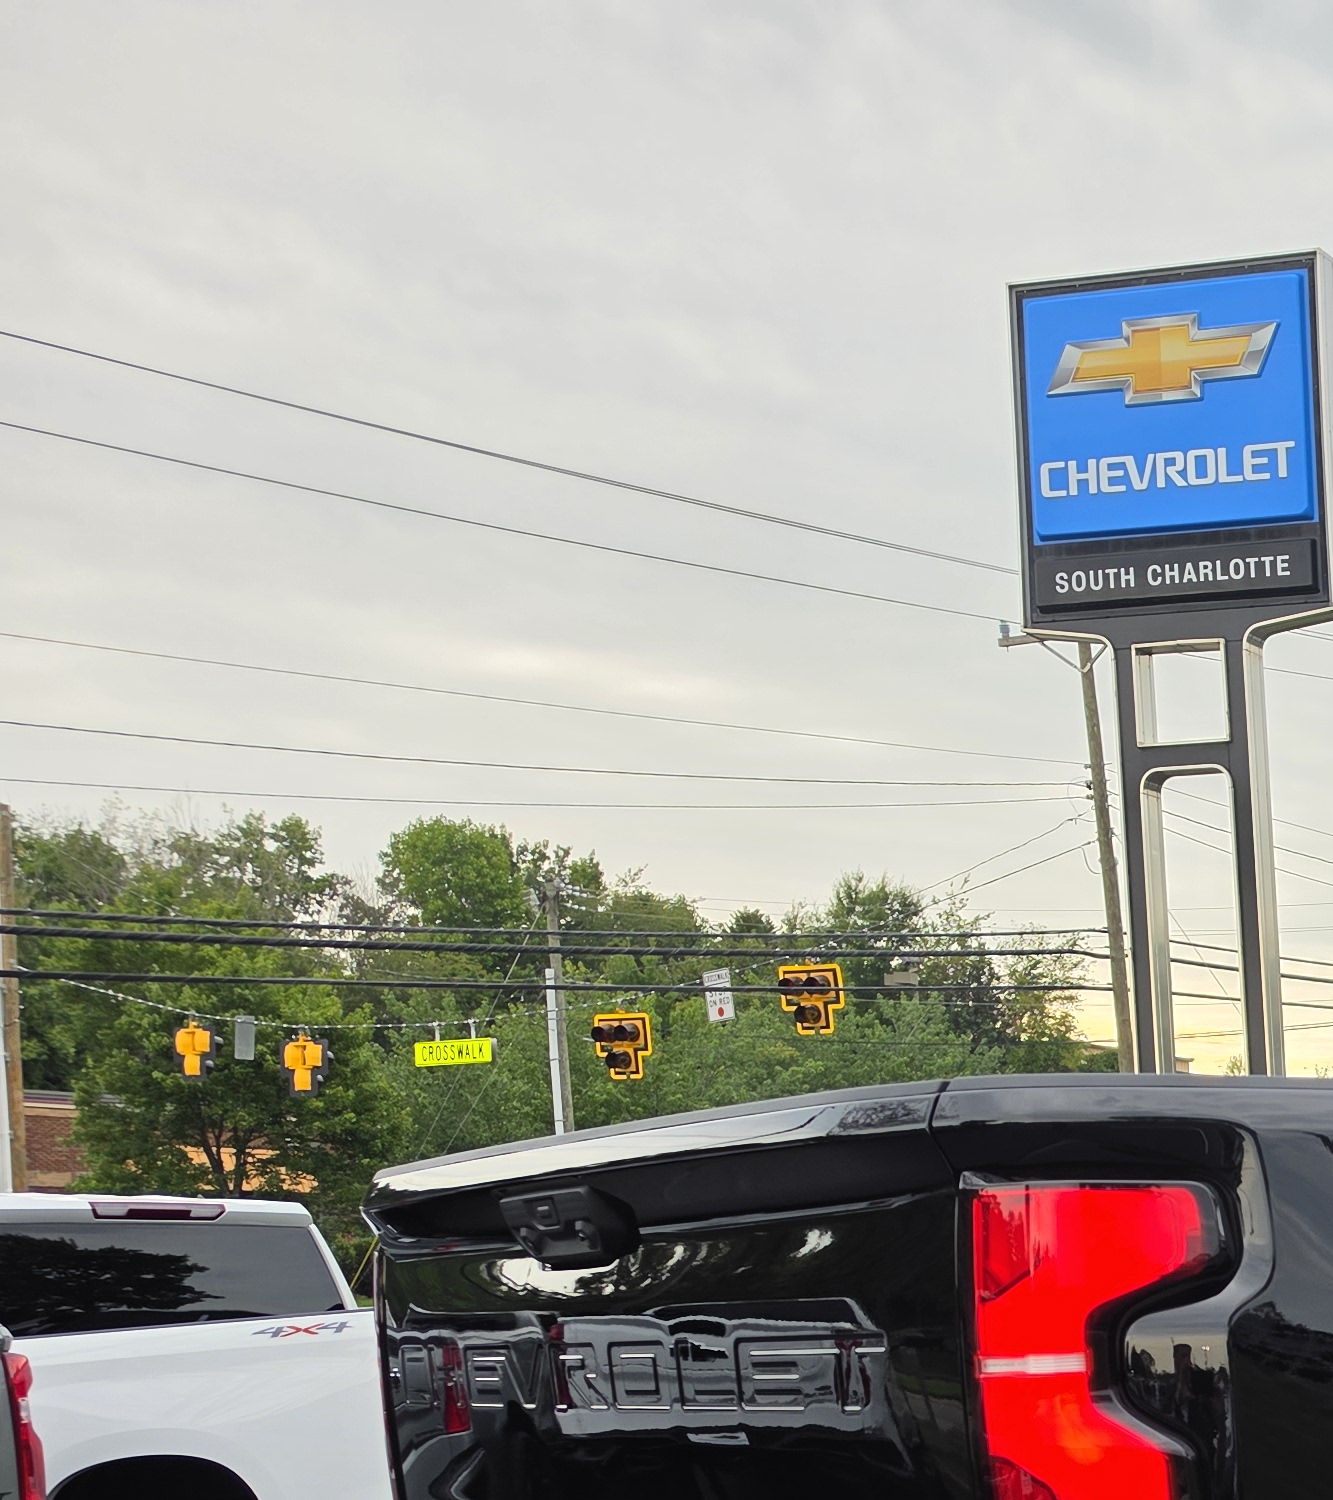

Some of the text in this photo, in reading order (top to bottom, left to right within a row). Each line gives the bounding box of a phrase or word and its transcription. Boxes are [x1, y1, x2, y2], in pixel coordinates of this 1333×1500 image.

[1040, 440, 1295, 498] CHEVROLET
[1054, 554, 1291, 595] SOUTH CHARLOTTE
[421, 1042, 485, 1062] CROSSWALK
